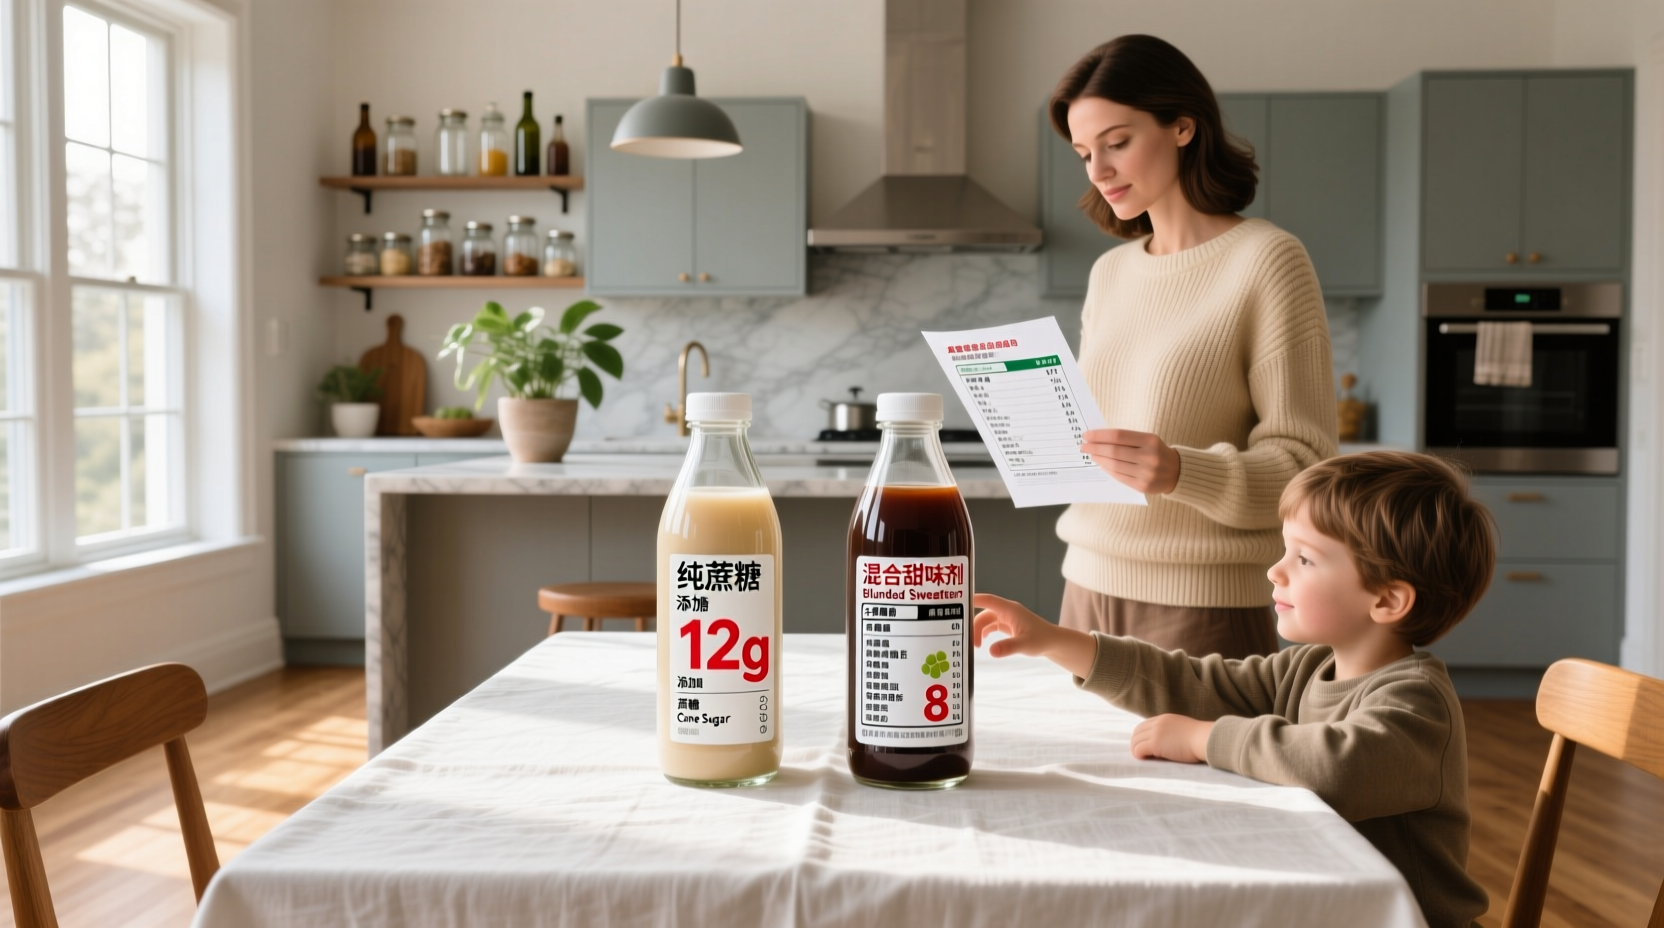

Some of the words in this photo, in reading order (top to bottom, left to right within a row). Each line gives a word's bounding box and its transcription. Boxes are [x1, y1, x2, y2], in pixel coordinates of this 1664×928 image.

[677, 560, 761, 592] 纯蔗糖
[863, 563, 964, 587] 混合甜味剂
[680, 618, 769, 683] 12g
[923, 684, 949, 722] 8
[677, 712, 700, 724] Cane
[702, 713, 731, 727] Sugar
